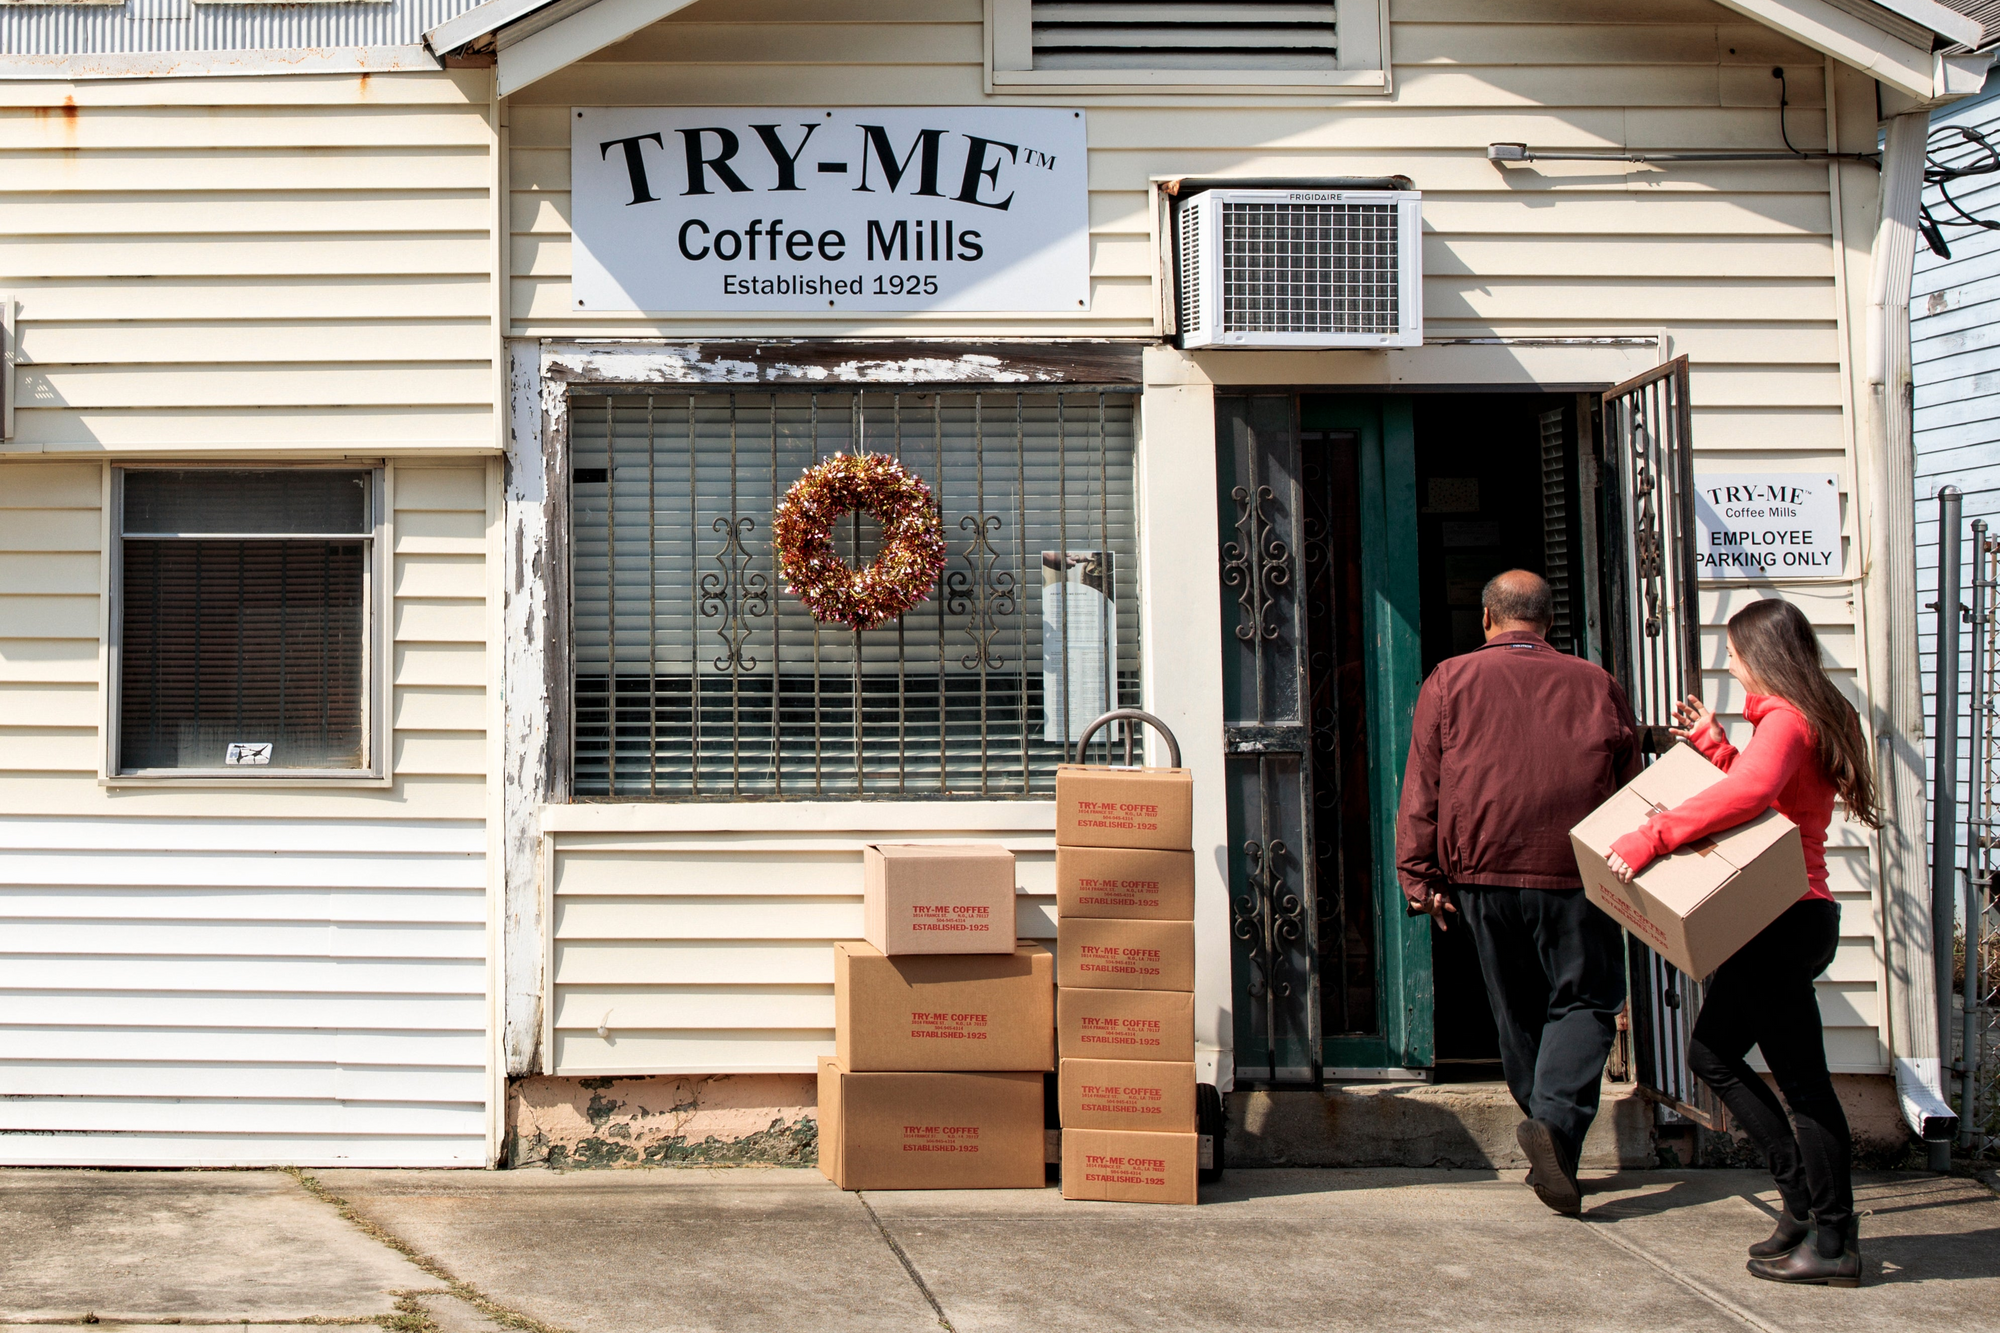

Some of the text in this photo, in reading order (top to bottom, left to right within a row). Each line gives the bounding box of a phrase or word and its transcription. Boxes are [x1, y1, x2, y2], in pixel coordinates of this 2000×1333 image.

[1289, 193, 1342, 201] FRIGIDAIRE
[677, 218, 985, 262] Coffee Mills
[723, 275, 939, 295] Established 1925
[1726, 507, 1797, 518] Coffee Mills
[1711, 530, 1813, 546] EMPLOYEE
[1783, 551, 1832, 566] ONLY
[1078, 802, 1158, 812] TRY-ME COFFEE
[1078, 820, 1157, 830] ESTABLISHED-1925
[1079, 879, 1159, 889] TRY-ME COFFEE
[1079, 897, 1159, 906] ESTABLISHED-1925
[1081, 946, 1160, 957] TRY-ME COFFEE
[1081, 964, 1160, 975] ESTABLISHED-1925
[1082, 1017, 1160, 1028] TRY-ME COFFEE
[912, 1031, 987, 1039] ESTABLISHED-1925
[1081, 1036, 1160, 1045] ESTABLISHED-1925
[1082, 1086, 1161, 1096] TRY-ME COFFEE
[1082, 1104, 1161, 1113] ESTABLISHED-1925
[903, 1126, 940, 1134] TRY-ME
[1086, 1155, 1165, 1167] TRY-ME COFFEE
[1086, 1174, 1165, 1185] ESTABLISHED-1925
